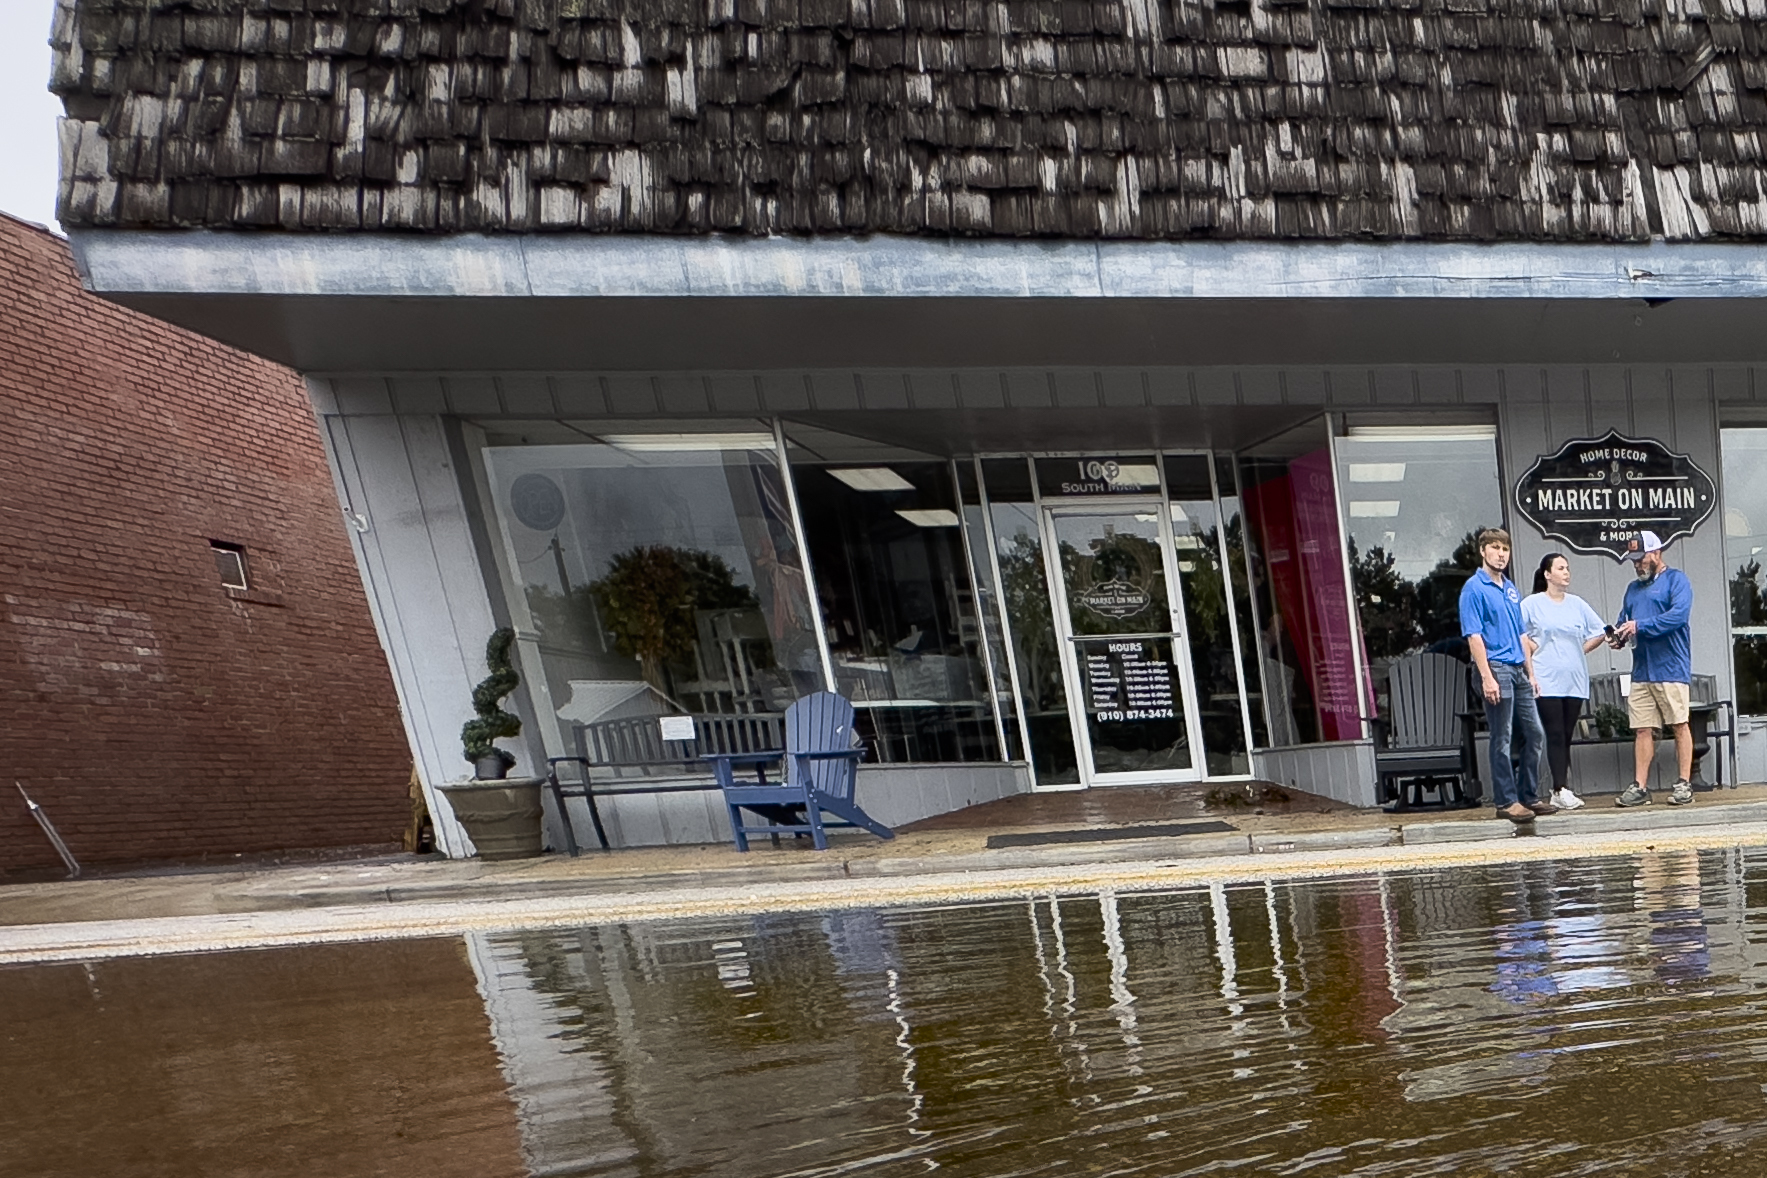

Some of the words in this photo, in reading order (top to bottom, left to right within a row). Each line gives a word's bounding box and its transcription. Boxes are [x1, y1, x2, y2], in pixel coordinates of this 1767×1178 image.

[1579, 448, 1610, 463] HOME
[1613, 448, 1648, 462] DECOR
[1061, 482, 1104, 493] SOUTH
[1537, 488, 1613, 511] MARKET
[1618, 488, 1643, 510] ON
[1649, 487, 1695, 509] MAIN
[1599, 531, 1607, 541] &
[1108, 643, 1143, 653] HOURS
[1097, 710, 1124, 722] (910)
